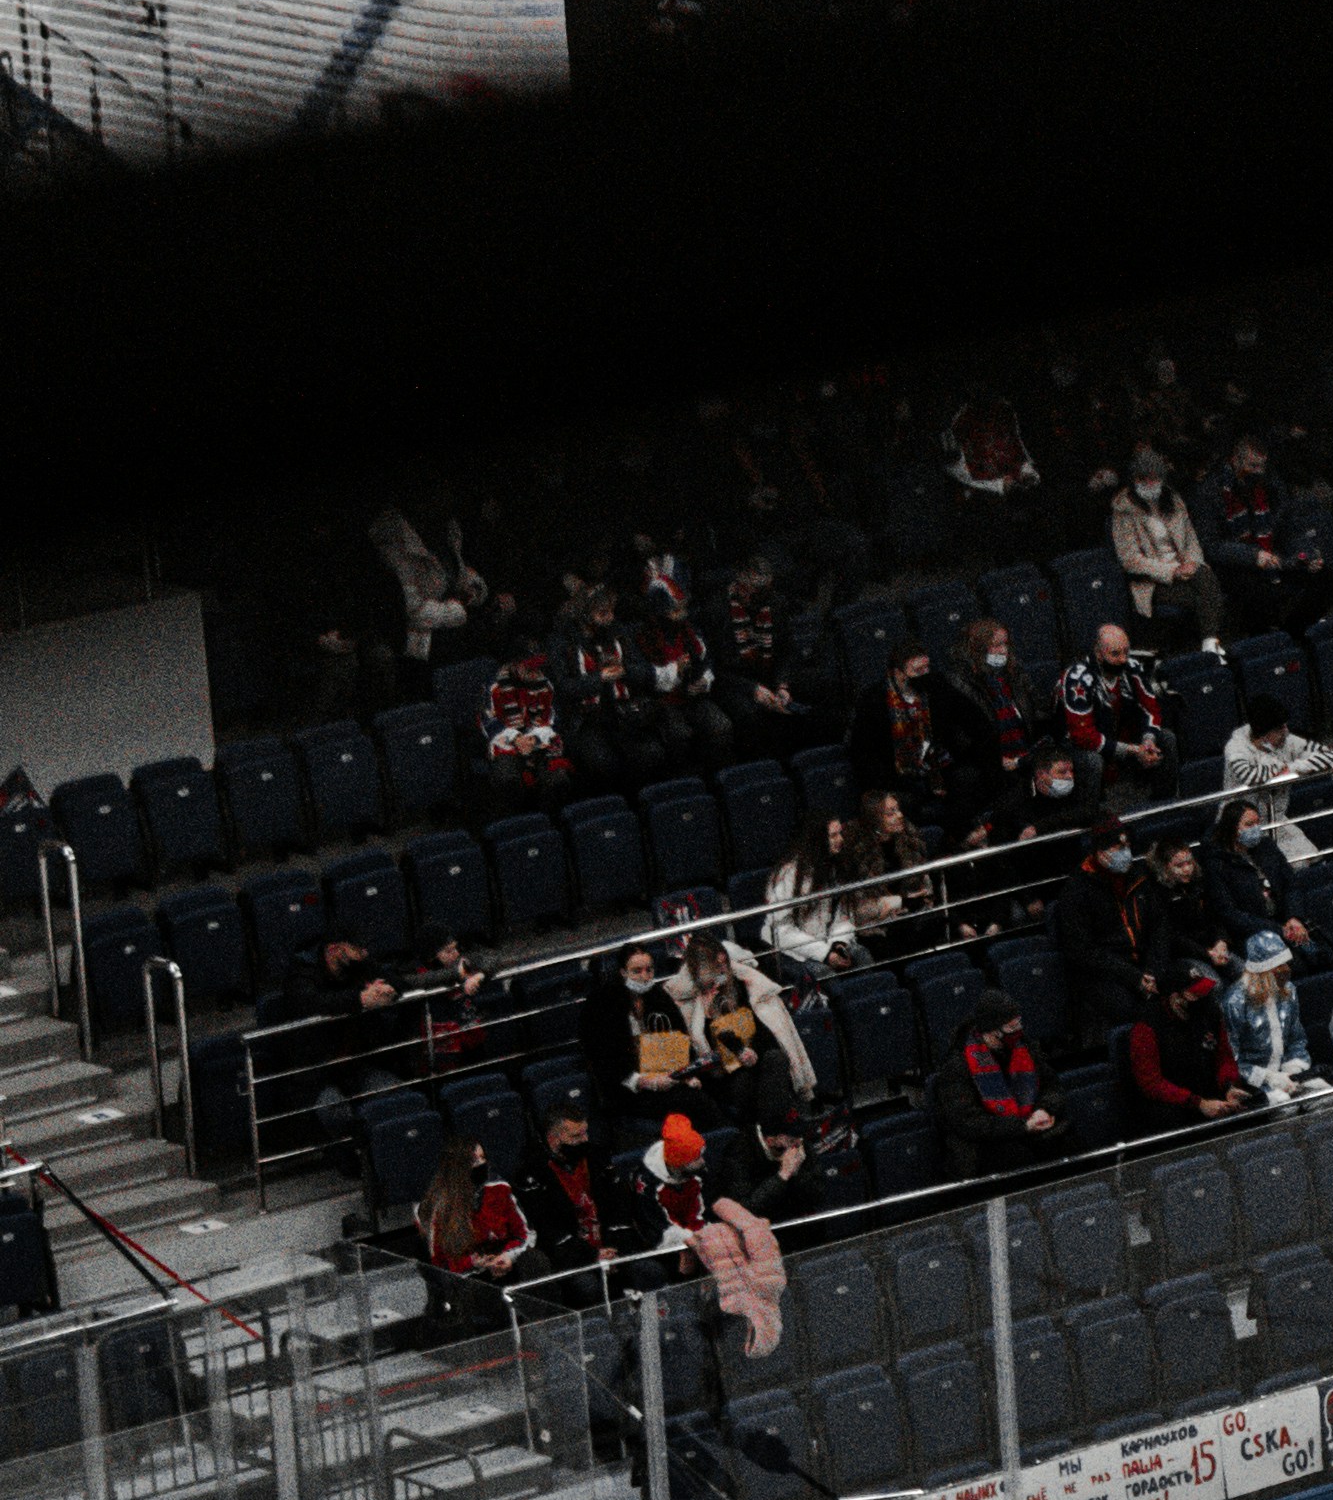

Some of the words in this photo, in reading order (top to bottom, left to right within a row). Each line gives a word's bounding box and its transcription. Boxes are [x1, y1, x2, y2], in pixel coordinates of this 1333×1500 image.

[1120, 1424, 1198, 1458] КАРНАУХОВ
[1058, 1457, 1082, 1477] МЫ
[1189, 1440, 1217, 1486] 15
[1064, 1482, 1077, 1495] НЕ
[1125, 1470, 1193, 1499] ГОРДОСТЬ
